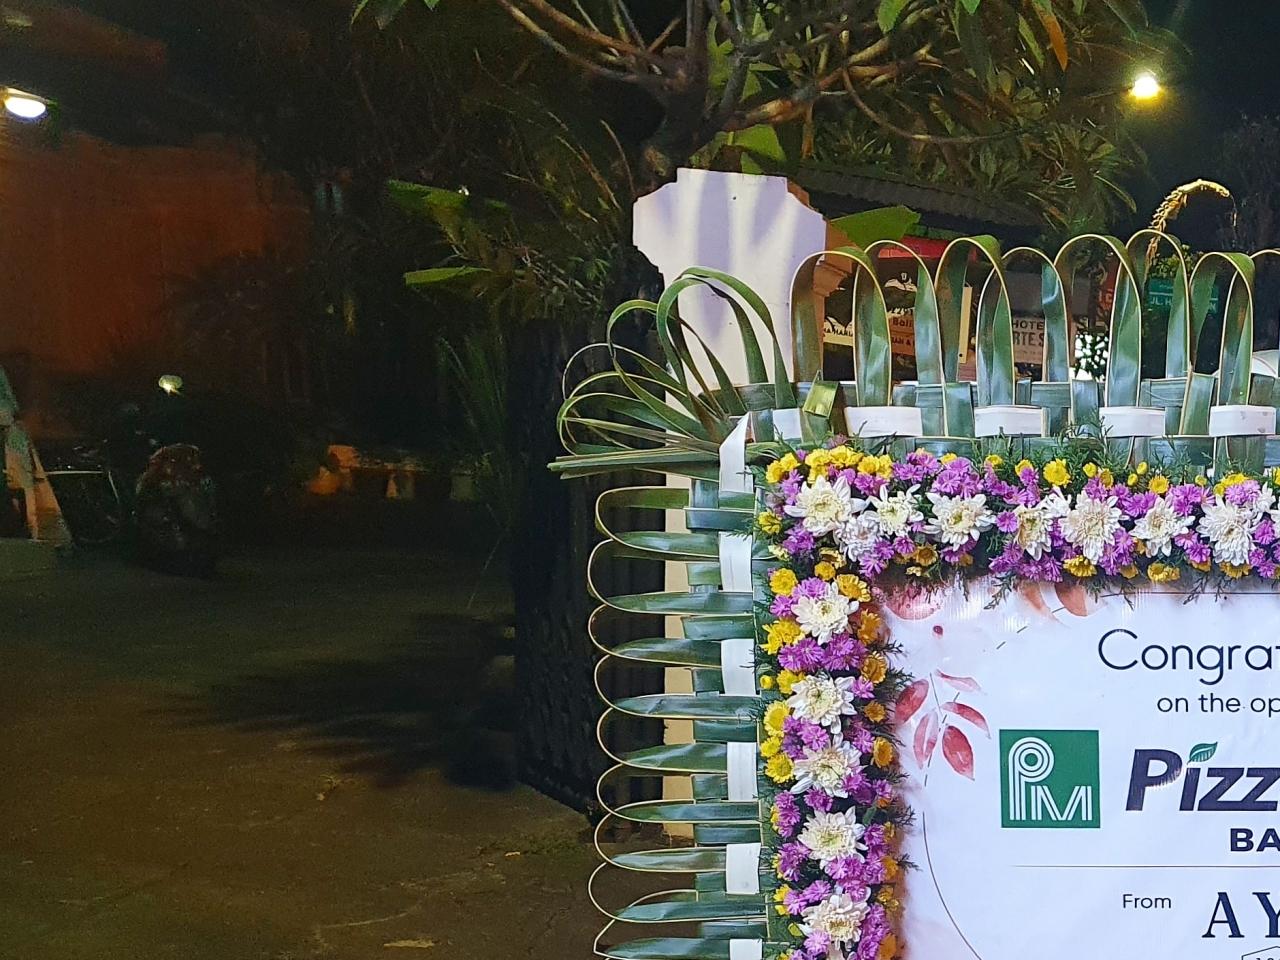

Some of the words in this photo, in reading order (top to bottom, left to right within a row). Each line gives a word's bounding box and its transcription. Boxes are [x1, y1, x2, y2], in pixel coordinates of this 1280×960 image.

[1012, 320, 1044, 330] HOTE
[1157, 698, 1188, 713] on
[1198, 693, 1241, 713] the
[1122, 893, 1172, 910] From
